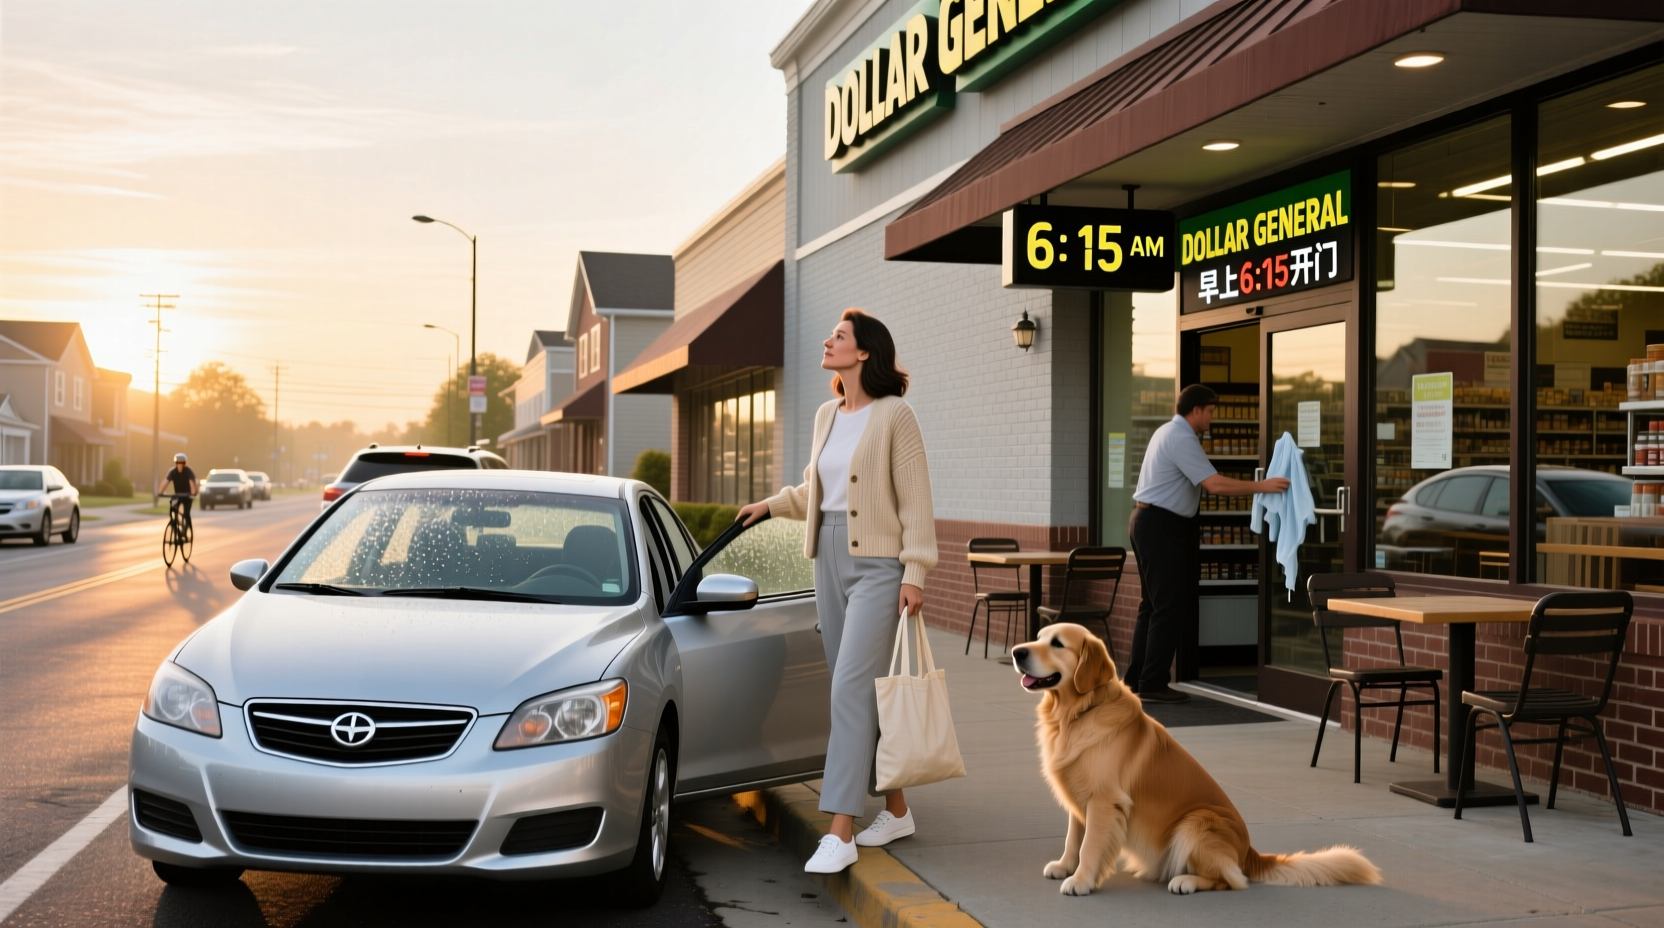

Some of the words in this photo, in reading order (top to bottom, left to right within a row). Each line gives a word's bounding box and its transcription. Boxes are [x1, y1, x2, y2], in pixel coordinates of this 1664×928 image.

[824, 13, 930, 161] DOLLAR
[938, 0, 1056, 75] GEN
[1129, 235, 1164, 258] AM
[1181, 221, 1250, 266] DOLLAR
[1253, 189, 1349, 247] GENERAL
[1197, 240, 1338, 305] 早上6:15开门
